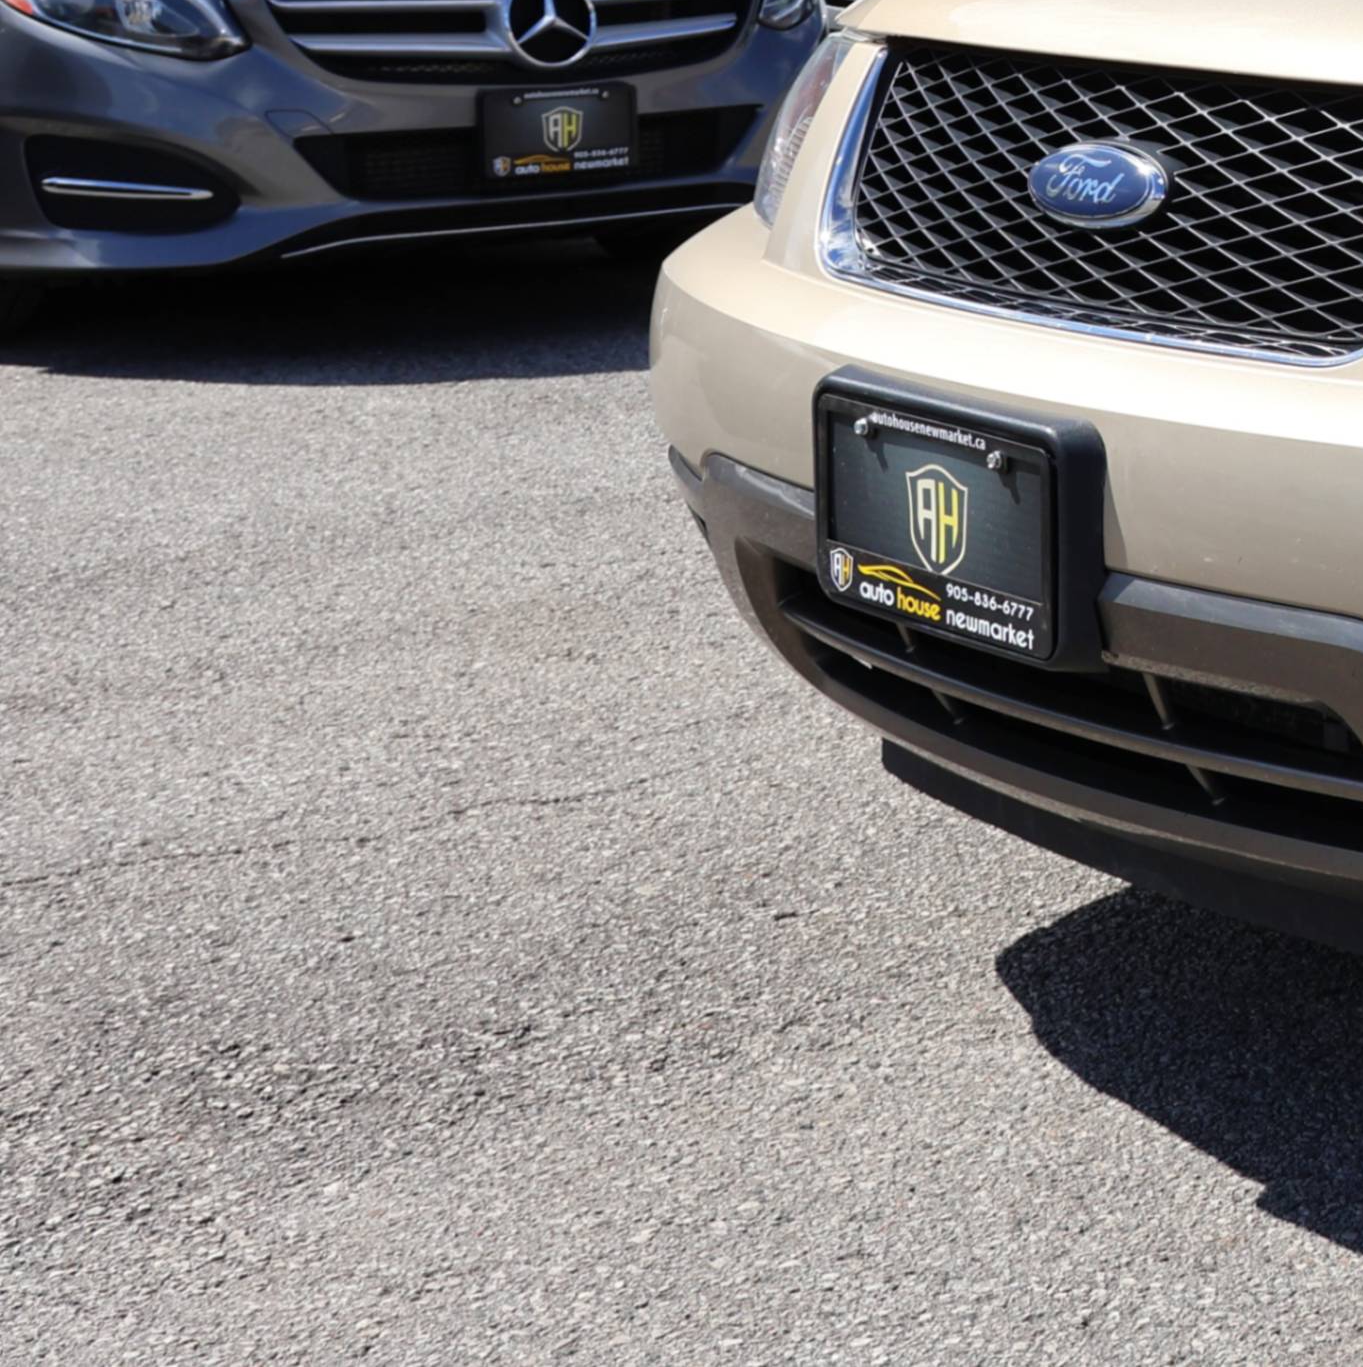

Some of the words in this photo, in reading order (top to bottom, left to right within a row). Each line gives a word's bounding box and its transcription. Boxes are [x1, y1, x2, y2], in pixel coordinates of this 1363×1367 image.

[1046, 153, 1125, 203] Ford
[869, 411, 987, 451] autohousenewmarket.ca
[859, 580, 895, 606] auto
[896, 586, 942, 622] house
[945, 583, 1035, 622] 905-836-6777
[945, 608, 1035, 651] newmarket
